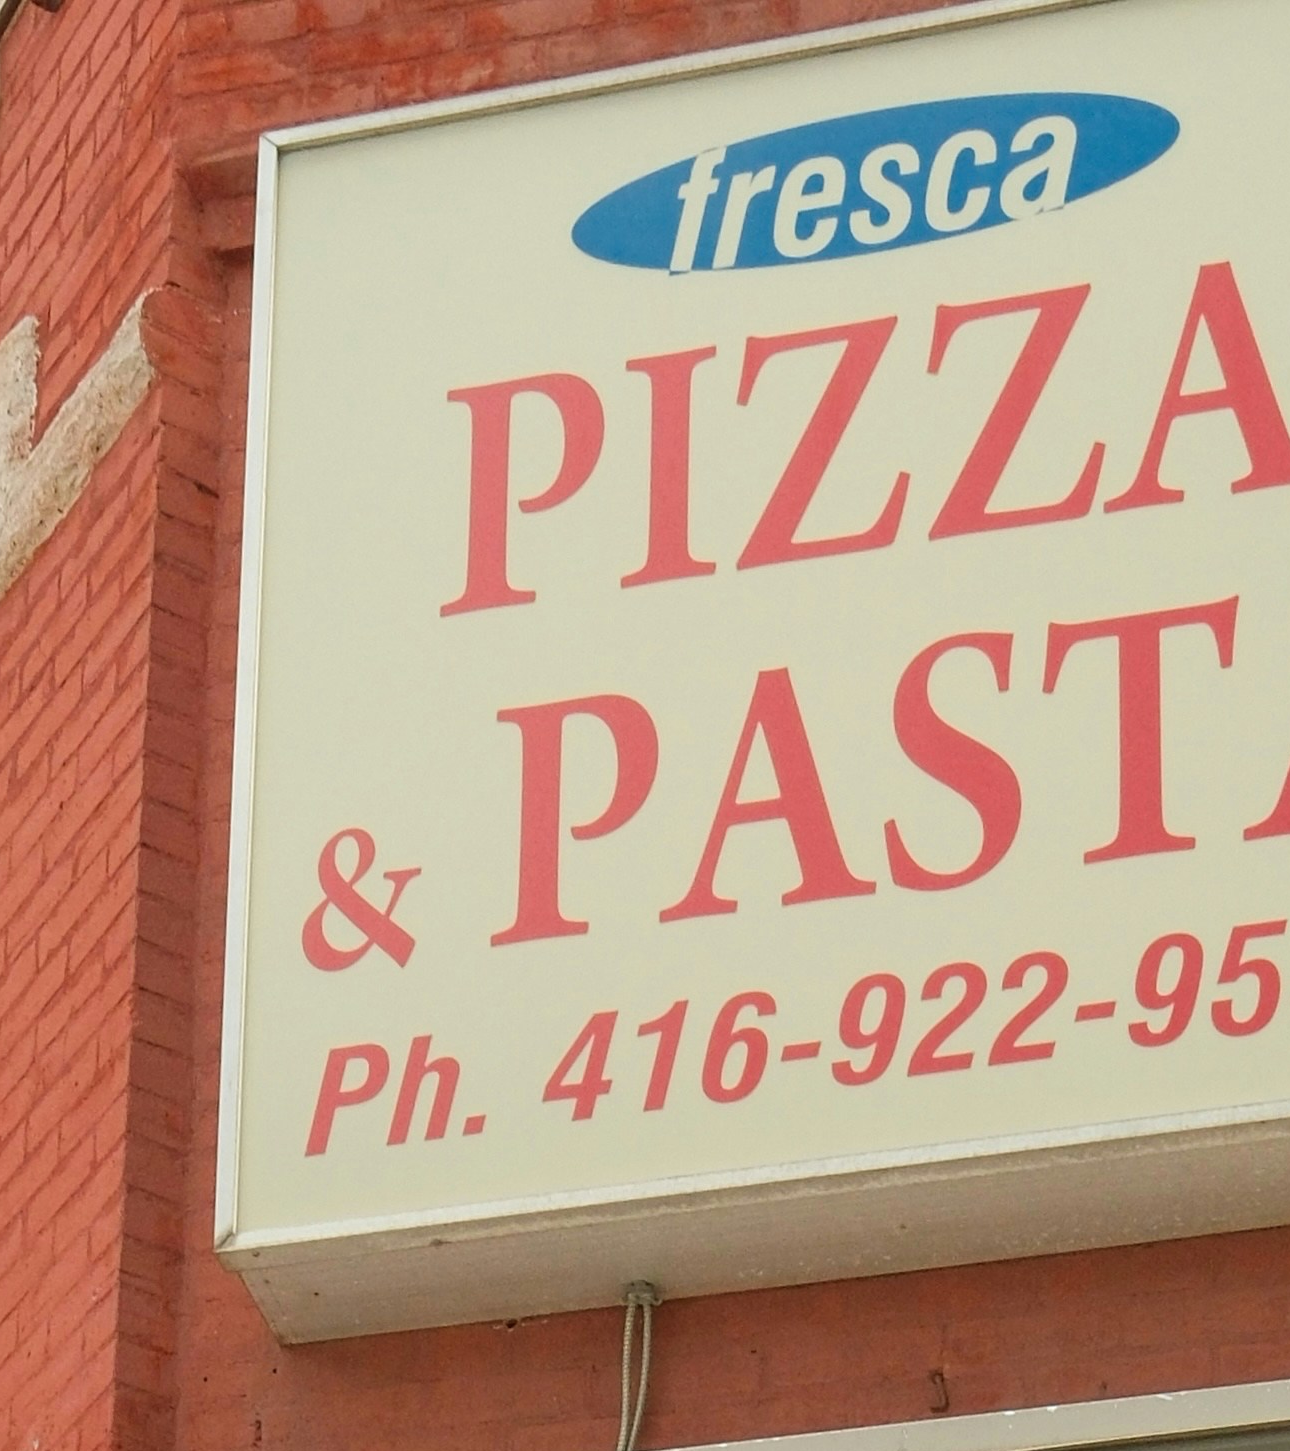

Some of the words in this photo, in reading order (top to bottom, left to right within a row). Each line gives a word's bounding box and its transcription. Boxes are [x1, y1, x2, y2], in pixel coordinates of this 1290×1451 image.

[667, 113, 1078, 275] fresca
[300, 826, 422, 972] &
[305, 1034, 486, 1157] Ph.
